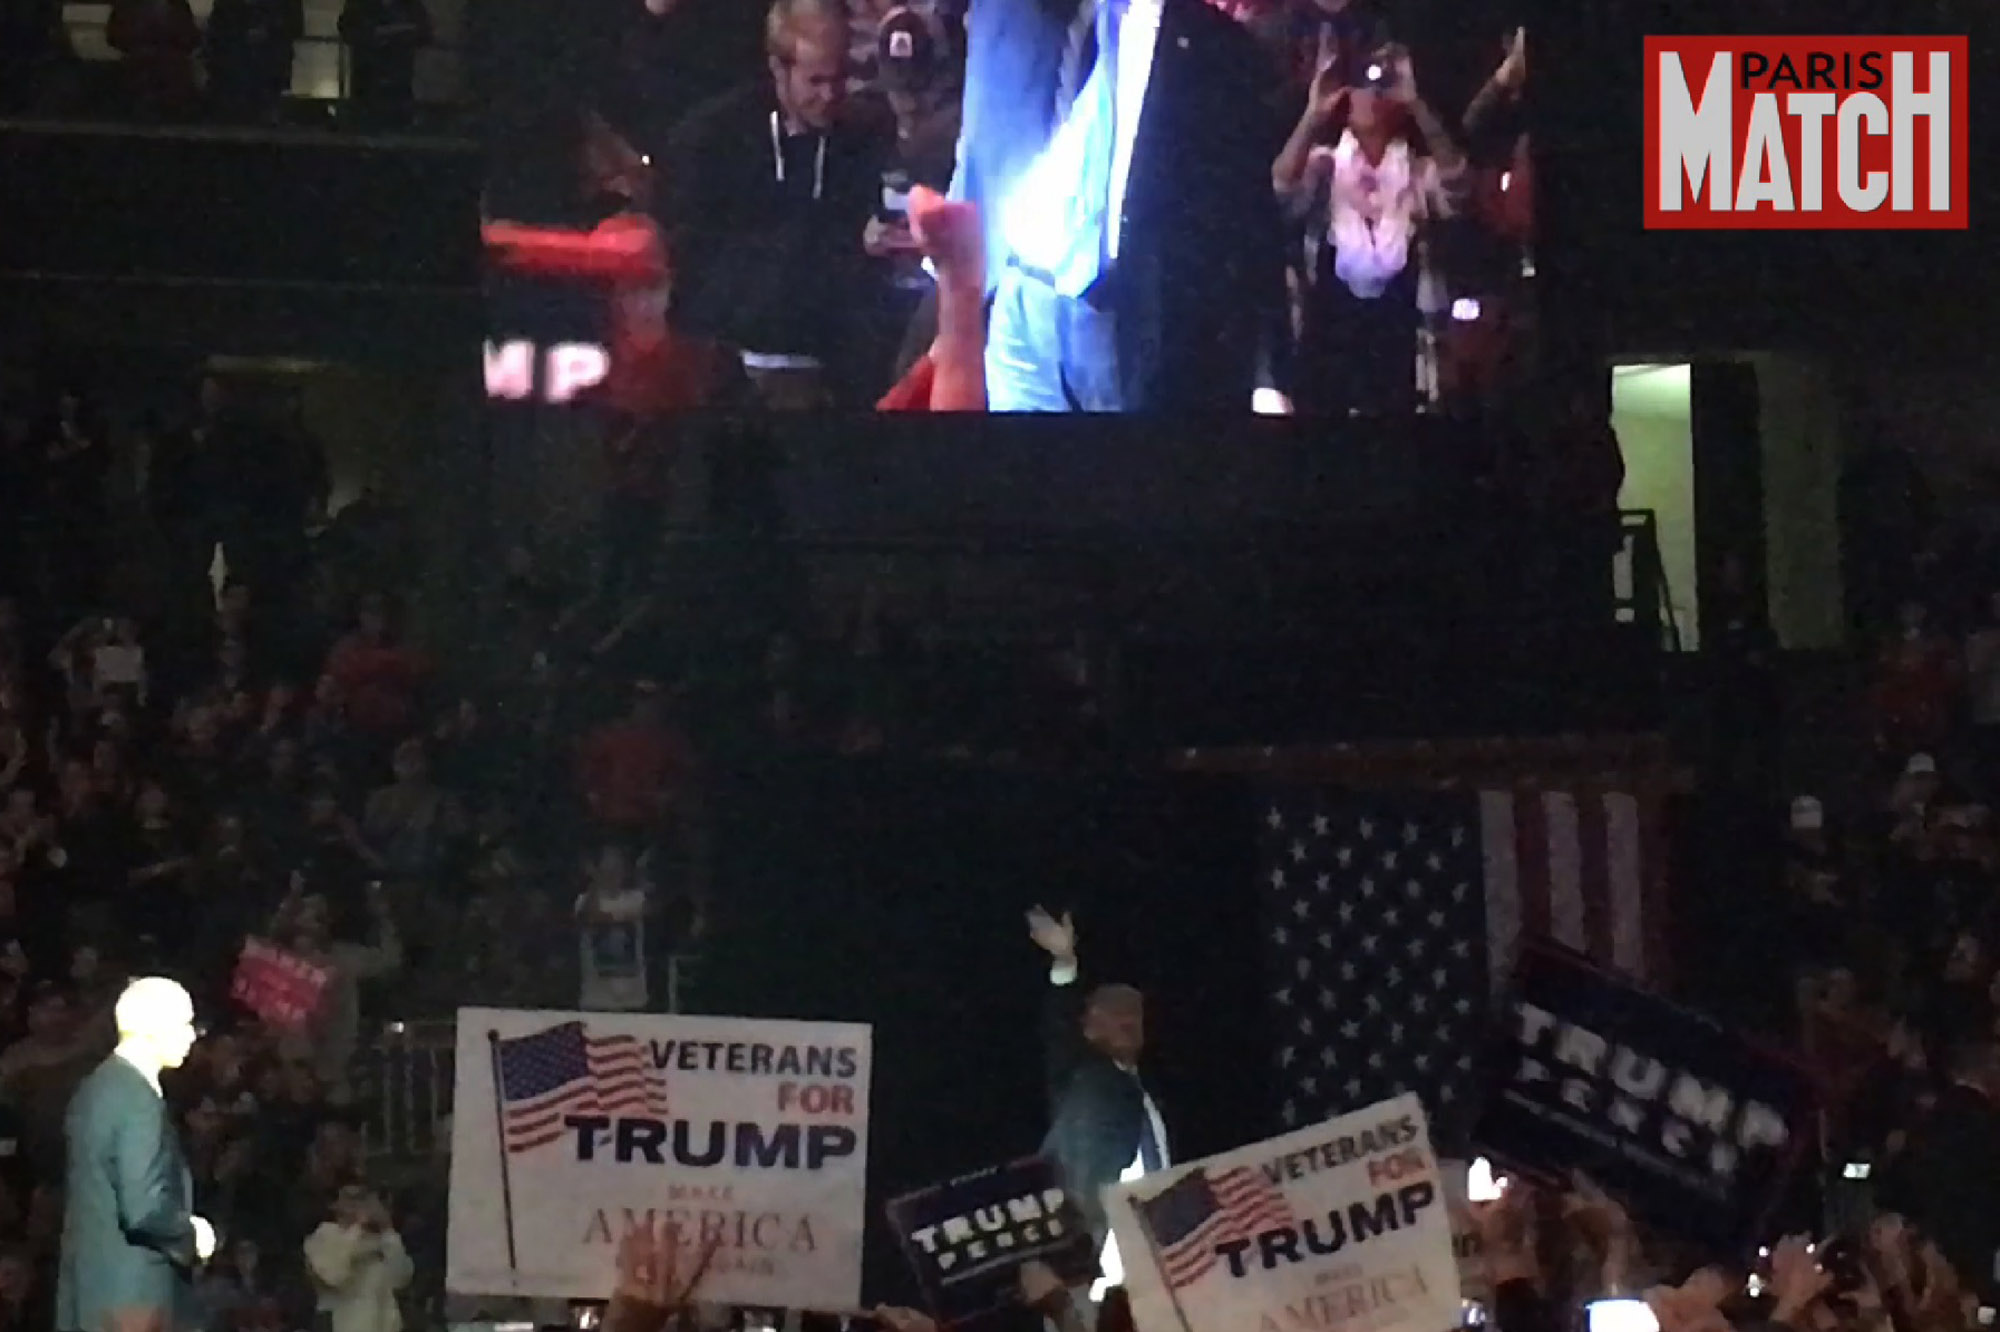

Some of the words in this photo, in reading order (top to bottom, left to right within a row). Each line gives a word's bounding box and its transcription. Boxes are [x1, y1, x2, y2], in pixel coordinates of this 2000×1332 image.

[648, 1038, 858, 1078] VETERANS
[1514, 1002, 1789, 1150] TRUMP
[777, 1081, 855, 1115] FOR
[564, 1114, 858, 1170] TRUMP
[1263, 1114, 1417, 1187] VETERANS
[1367, 1150, 1427, 1189] FOR
[582, 1207, 819, 1252] AMERICA
[911, 1188, 1065, 1253] TRUMP
[1213, 1182, 1436, 1279] TRUMP
